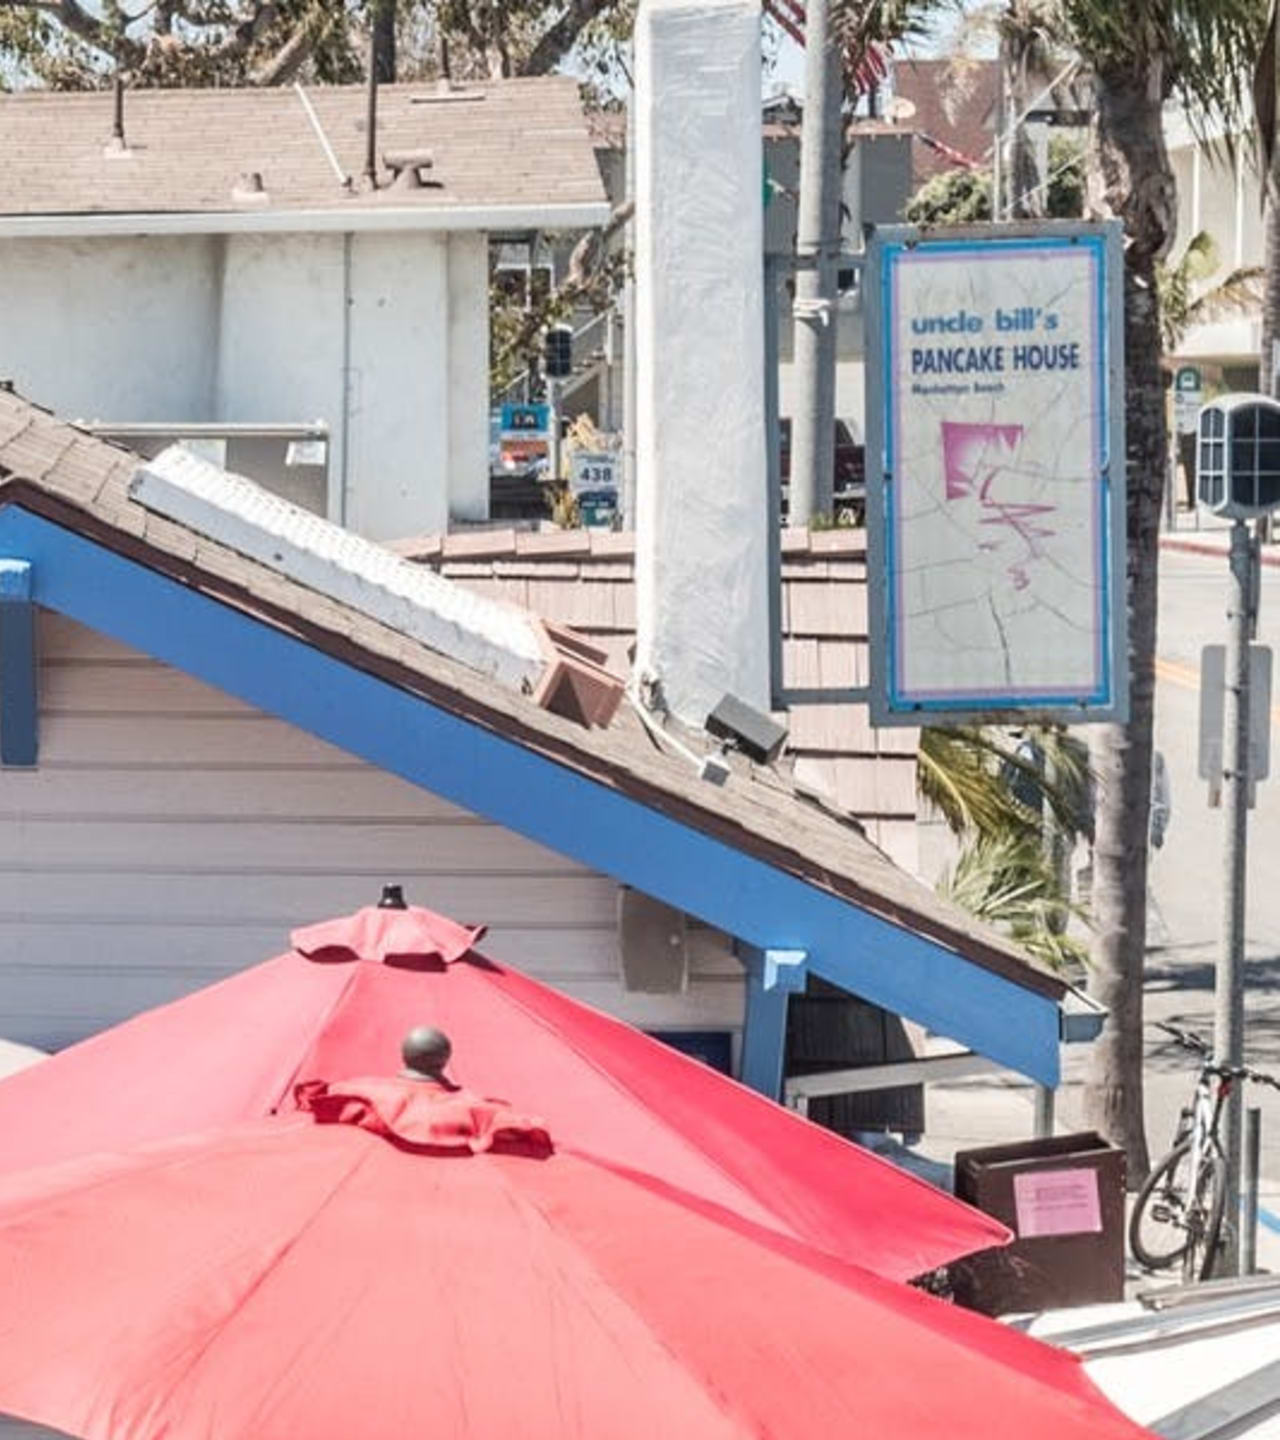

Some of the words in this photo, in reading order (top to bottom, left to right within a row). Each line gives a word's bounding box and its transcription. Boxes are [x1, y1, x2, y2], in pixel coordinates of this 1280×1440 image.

[911, 310, 984, 335] uncle
[995, 307, 1059, 332] bill's
[911, 346, 1004, 374] PANCAKE
[1013, 342, 1080, 371] HOUSE
[580, 467, 612, 482] 438
